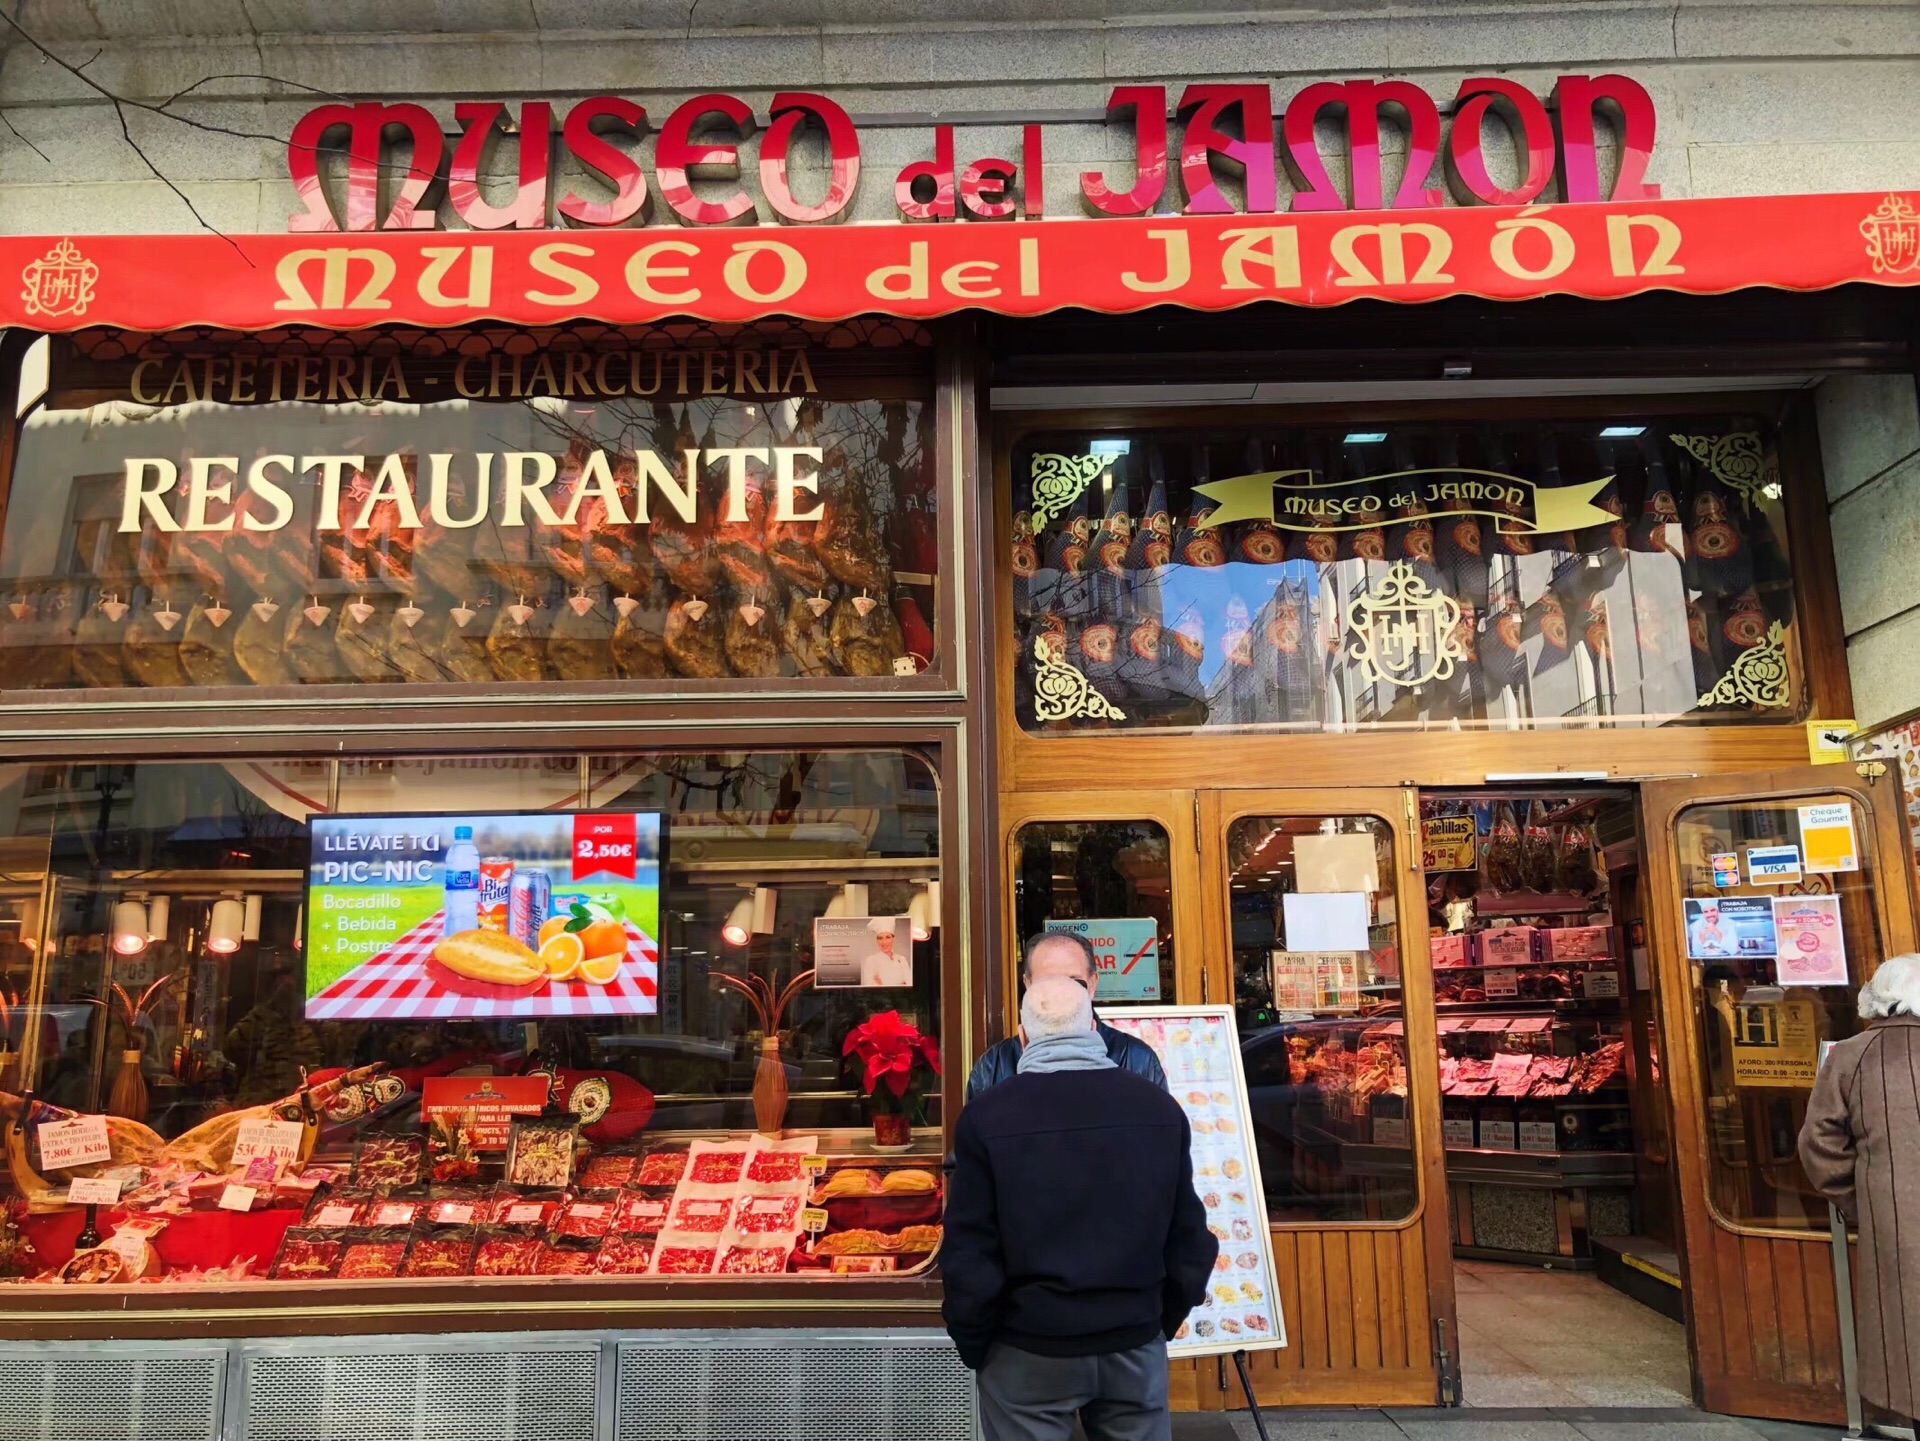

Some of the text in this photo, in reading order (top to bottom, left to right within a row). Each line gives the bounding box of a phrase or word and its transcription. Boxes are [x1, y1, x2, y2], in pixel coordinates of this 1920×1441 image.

[288, 74, 1661, 233] MUSEO del JAMON
[273, 206, 1686, 312] MUSEO del JAMÓN
[130, 353, 411, 405] CAFETERIA
[454, 349, 819, 399] CHARCUTERIA
[117, 446, 825, 533] RESTAURANTE
[1283, 481, 1525, 515] MUSEO del JAMON
[1809, 807, 1843, 817] Cheque
[1810, 814, 1849, 825] Gourmet
[593, 825, 613, 834] POR
[325, 832, 404, 851] LLÉVATE
[577, 839, 633, 859] 2,50€
[323, 859, 434, 883] PIC-NIC
[1762, 864, 1788, 874] VISA
[484, 878, 498, 891] Bi
[322, 893, 402, 910] Bocadillo
[480, 884, 509, 904] fruta
[337, 915, 397, 931] Bebida
[336, 937, 392, 953] Postre
[501, 1104, 542, 1112] ENVASADOS
[41, 1139, 65, 1149] EXTRA
[83, 1142, 108, 1154] Kilo
[270, 1145, 296, 1159] Kilo
